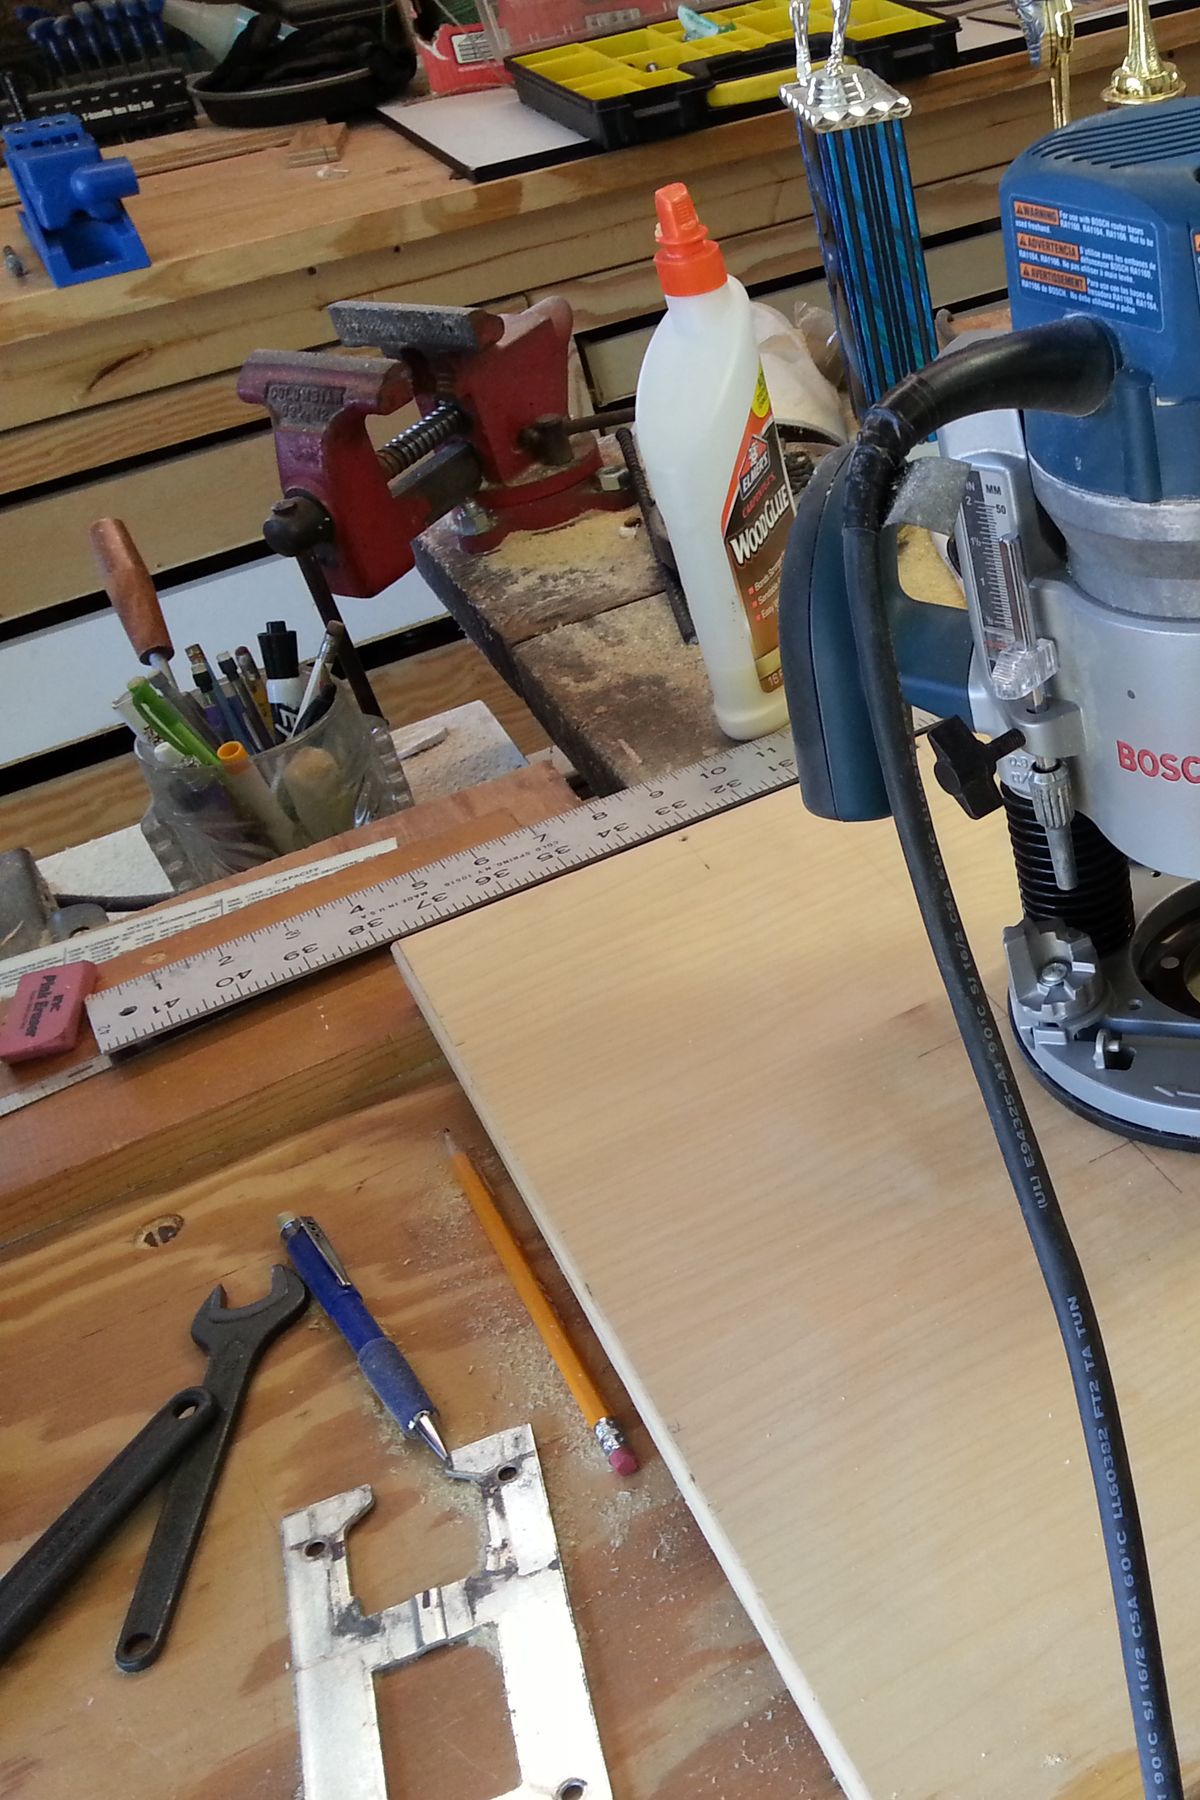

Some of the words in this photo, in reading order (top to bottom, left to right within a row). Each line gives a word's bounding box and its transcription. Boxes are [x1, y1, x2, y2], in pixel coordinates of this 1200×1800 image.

[985, 483, 1002, 496] MM
[995, 504, 1007, 514] 50
[768, 673, 779, 686] 16
[756, 747, 777, 758] 11
[700, 766, 727, 779] 10
[769, 758, 794, 772] 31
[649, 790, 664, 798] 9
[709, 778, 742, 794] 32
[592, 811, 608, 821] 8
[655, 800, 688, 815] 33
[533, 832, 547, 842] 7
[597, 822, 630, 839] 34
[473, 856, 490, 866] 6
[536, 845, 571, 862] 35
[274, 867, 320, 885] CAPACITY
[475, 868, 510, 886] 36
[411, 880, 428, 890] 5
[402, 890, 428, 903] MADE
[417, 892, 449, 911] 37
[349, 904, 366, 914] 4
[348, 917, 384, 936] 38
[282, 942, 320, 961] 39
[218, 955, 234, 967] 2
[37, 975, 56, 999] Pink
[215, 969, 253, 989] 40
[968, 976, 980, 996] SJ
[151, 998, 180, 1015] 41
[25, 1001, 49, 1037] Eraser
[1029, 1175, 1049, 1210] (UL)
[1066, 1296, 1087, 1339] TUN
[1081, 1344, 1095, 1373] TA
[1089, 1379, 1105, 1420] FT2
[1127, 1595, 1142, 1638] CSA
[1131, 1646, 1150, 1691] 16/2
[1144, 1702, 1154, 1721] SJ
